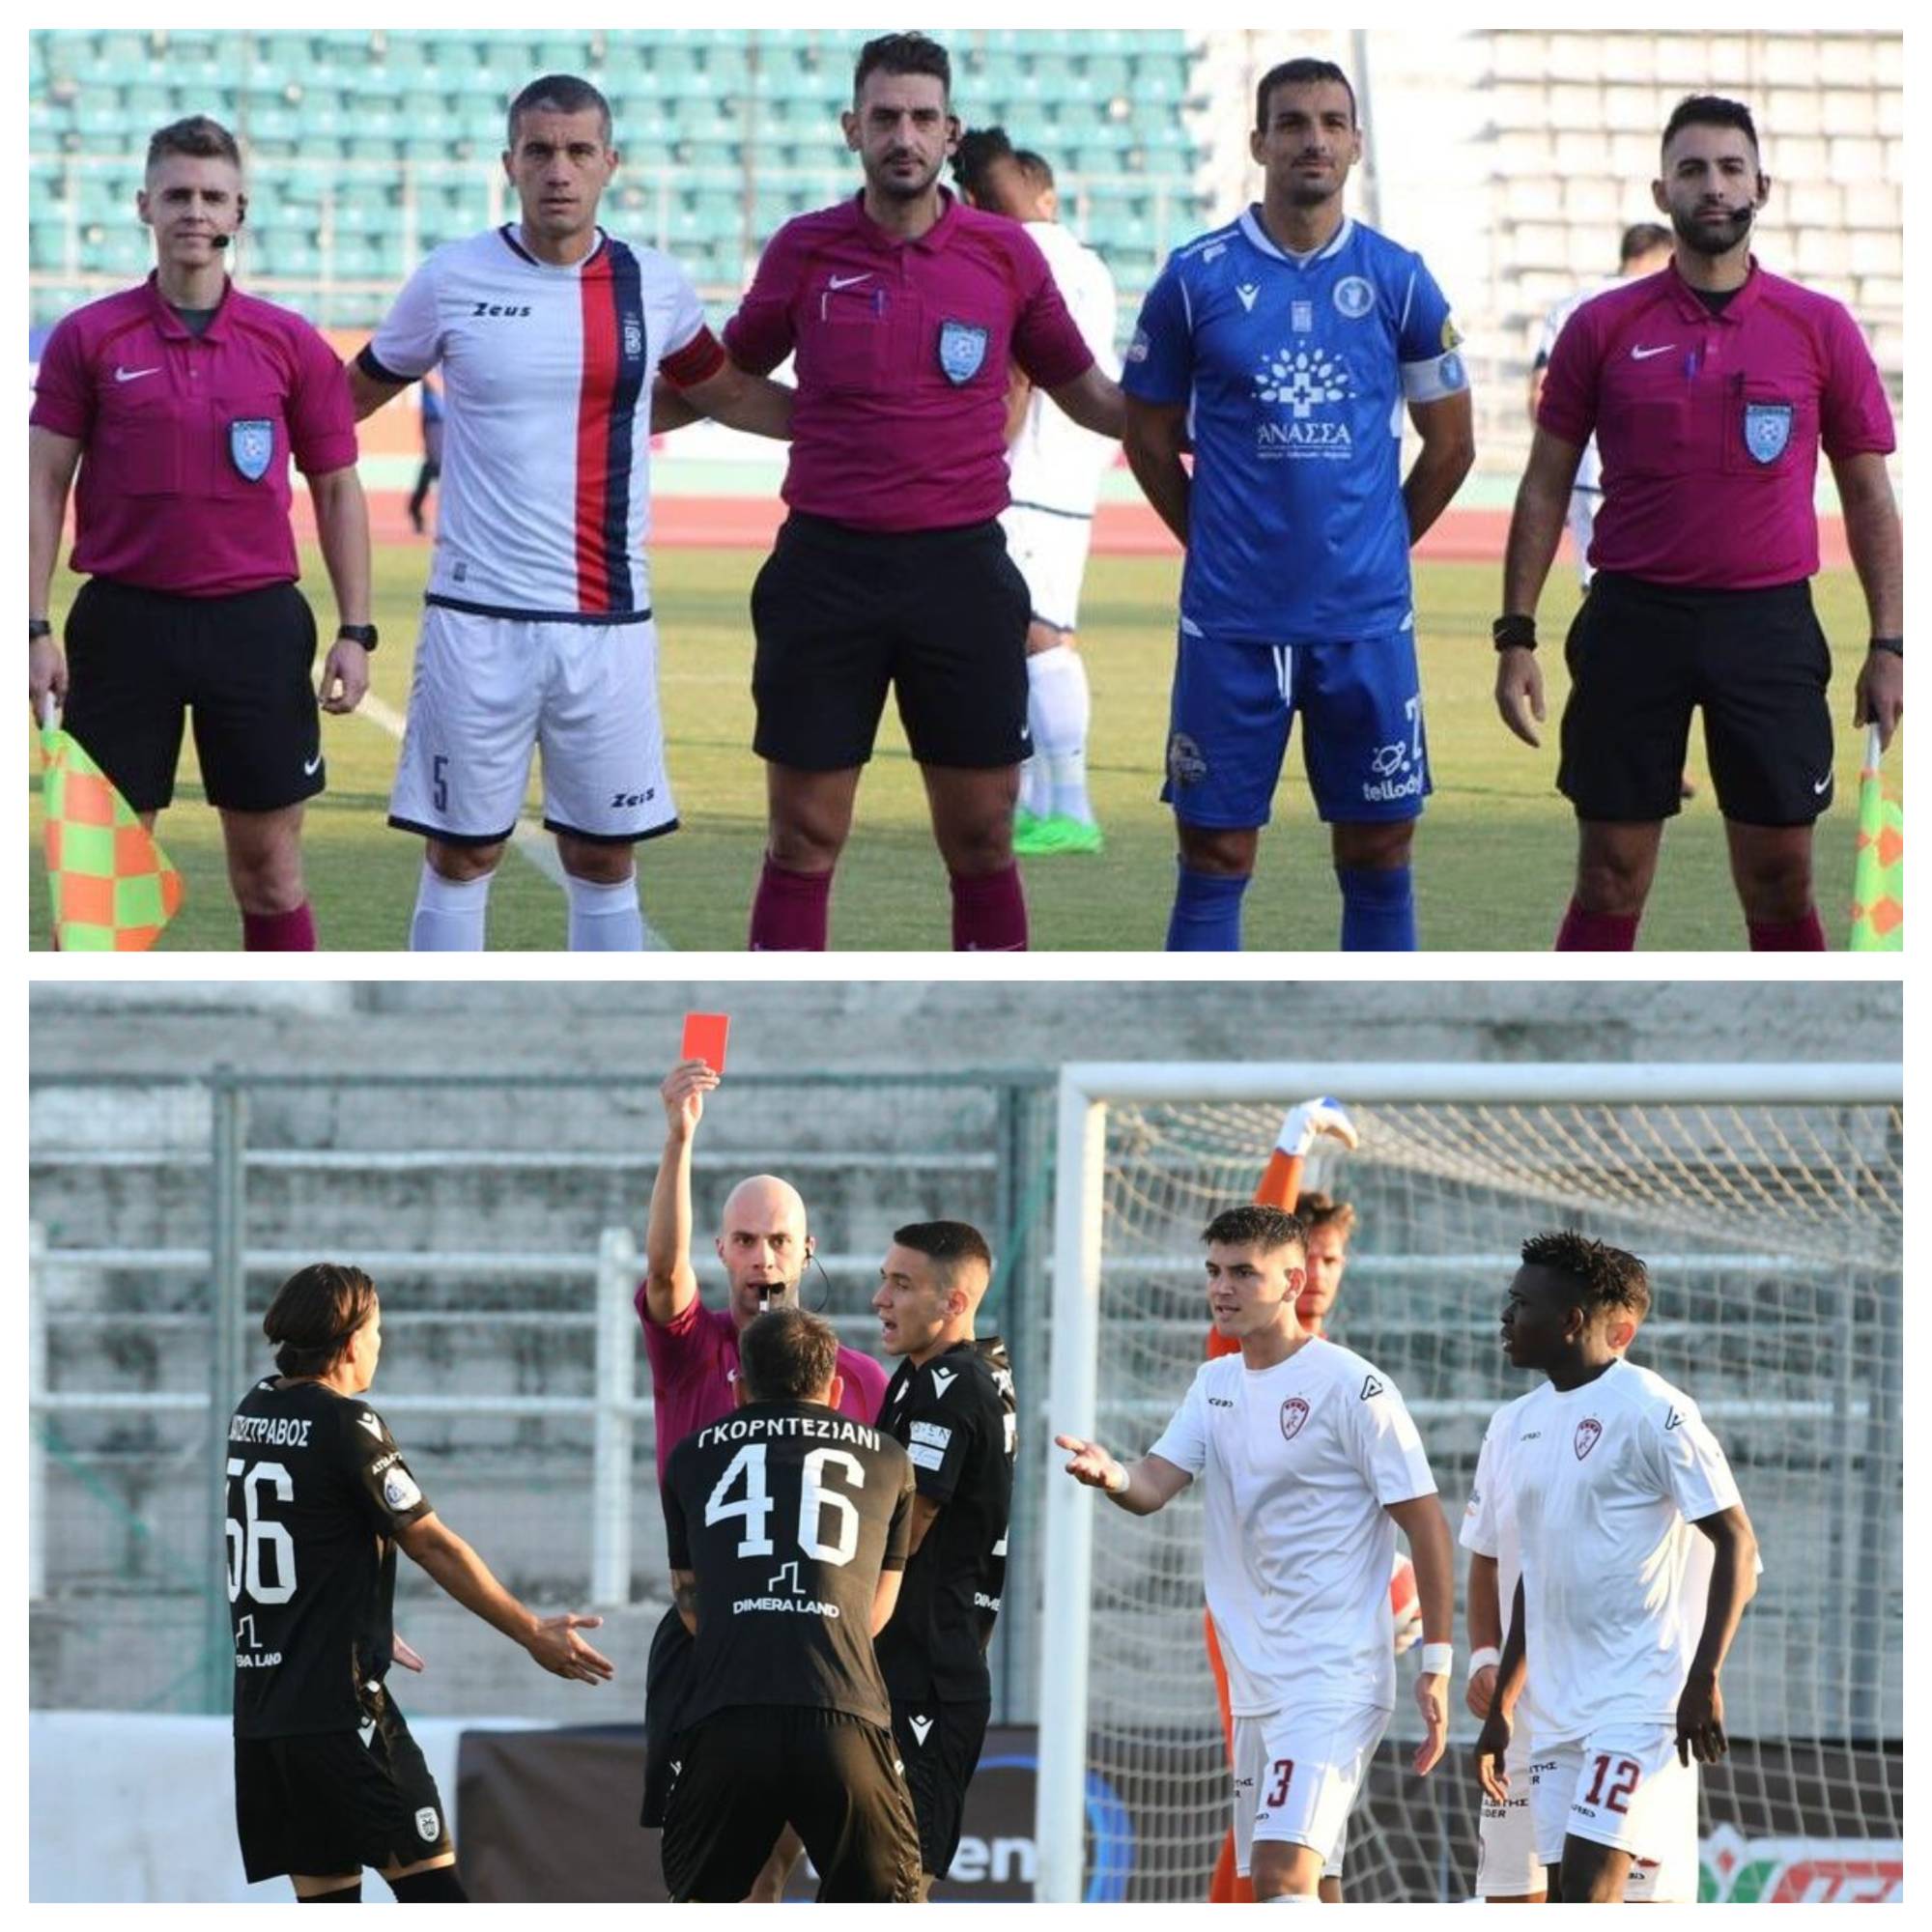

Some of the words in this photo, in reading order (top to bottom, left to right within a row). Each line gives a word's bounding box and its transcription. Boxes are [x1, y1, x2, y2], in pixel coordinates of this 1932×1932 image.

[472, 302, 531, 317] Zeus
[434, 754, 449, 812] 5
[225, 1458, 298, 1605] 56
[705, 1443, 866, 1567] 46
[733, 1598, 794, 1614] DIMERA
[797, 1600, 840, 1618] LAND
[1266, 1759, 1293, 1807] 3
[1585, 1753, 1641, 1814] 12
